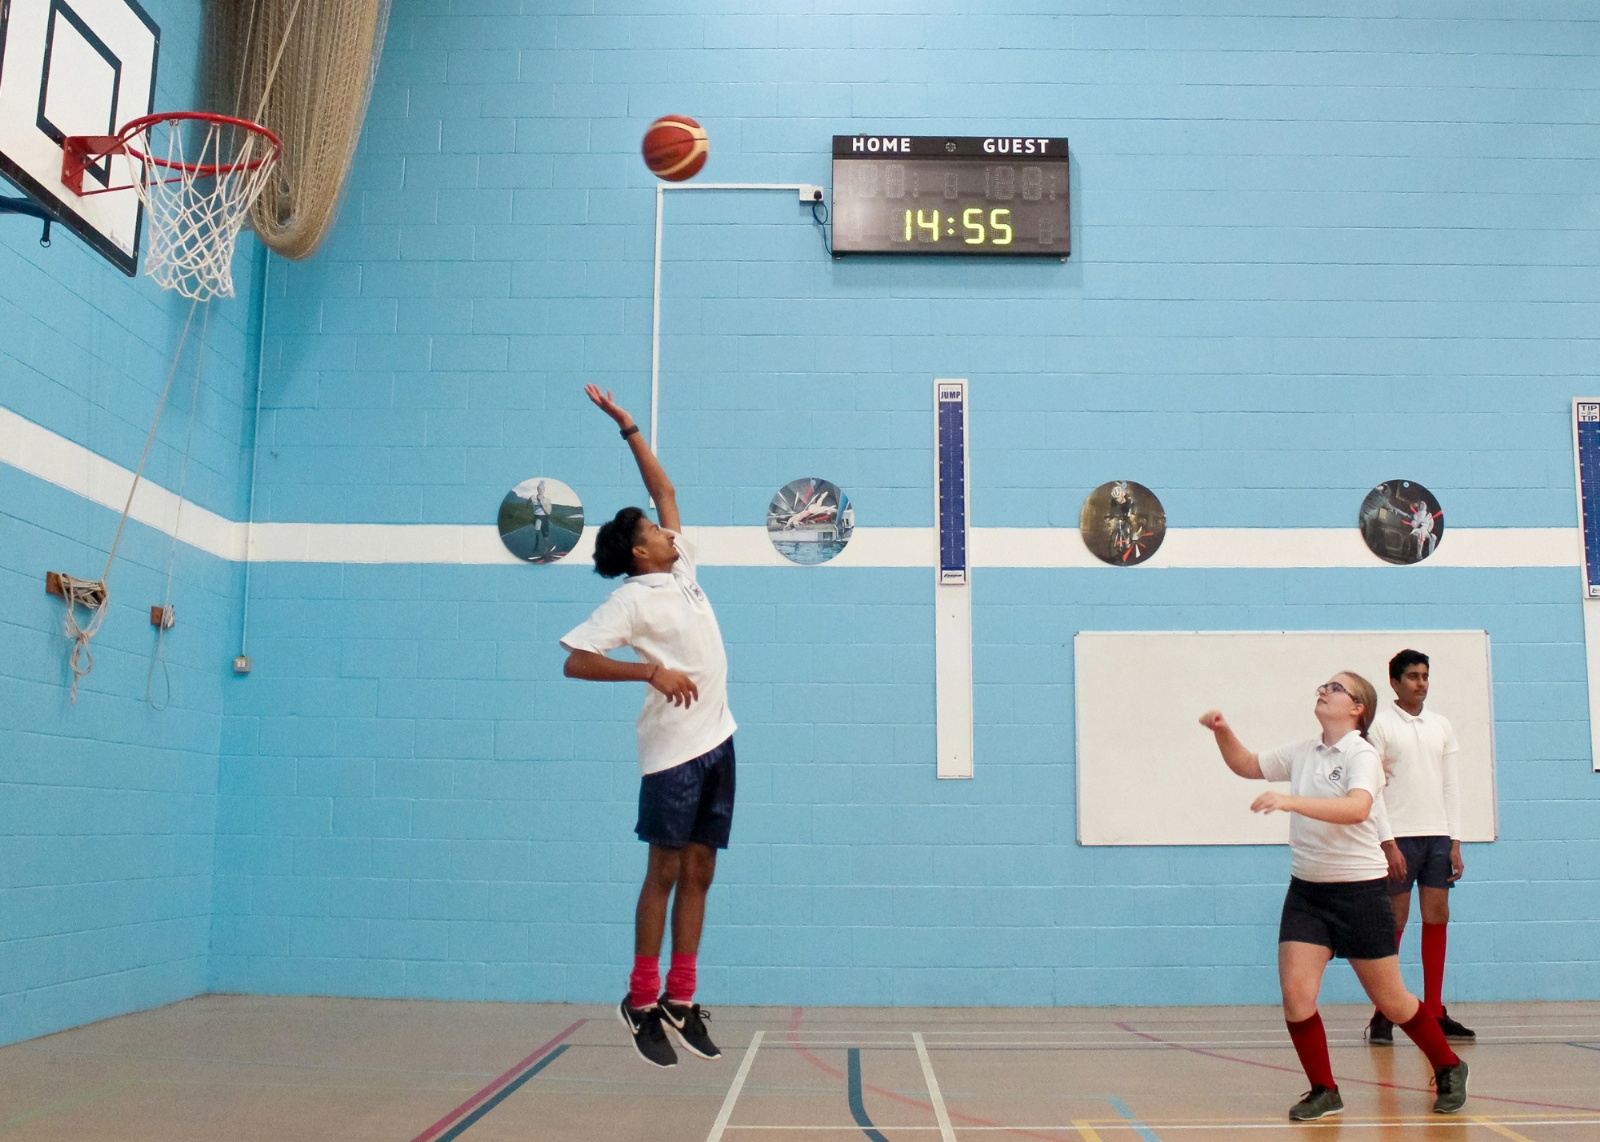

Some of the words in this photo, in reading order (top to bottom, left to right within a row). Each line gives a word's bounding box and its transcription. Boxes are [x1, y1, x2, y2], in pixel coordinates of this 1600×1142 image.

[852, 137, 911, 152] HOME
[983, 138, 1050, 154] GUEST
[904, 208, 1013, 245] 14:55
[941, 391, 961, 399] JUMP
